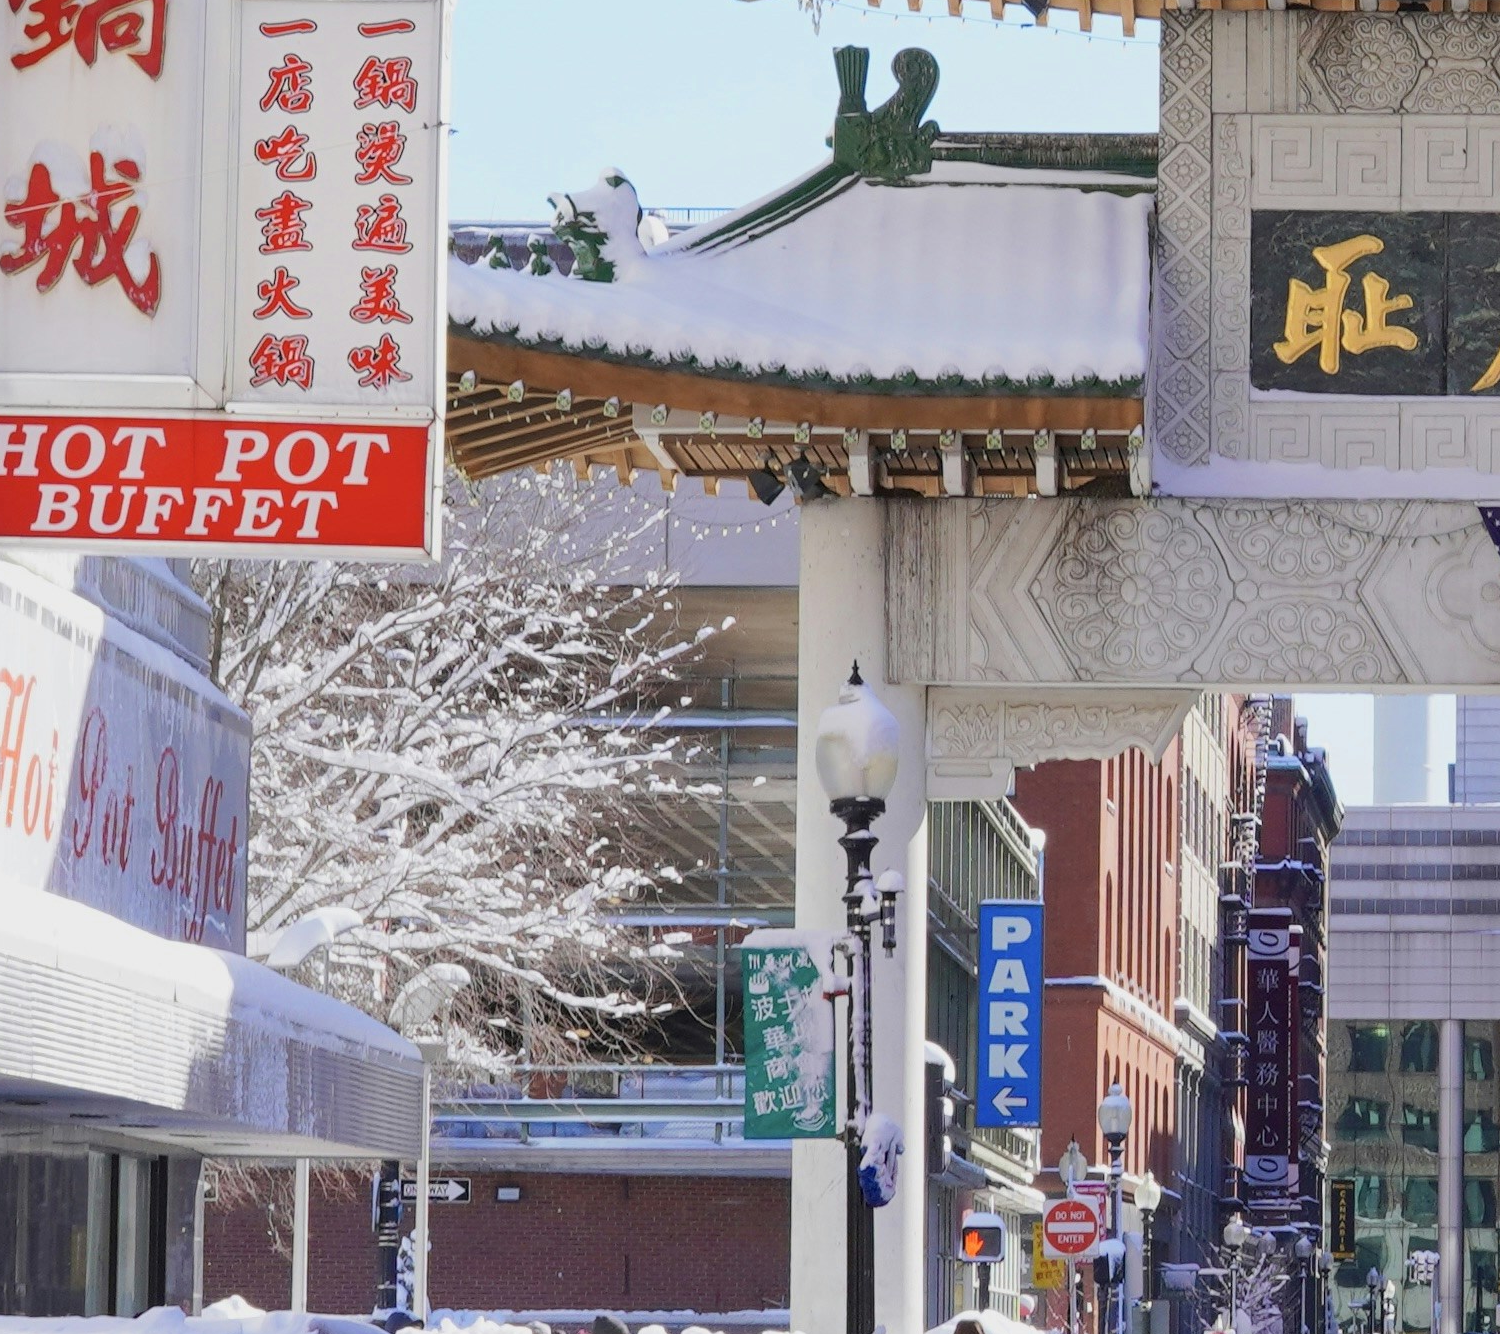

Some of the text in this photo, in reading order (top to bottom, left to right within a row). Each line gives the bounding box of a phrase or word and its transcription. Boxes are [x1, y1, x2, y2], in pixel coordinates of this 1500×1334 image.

[249, 18, 317, 391] 一店吃盡火鍋
[214, 430, 391, 486] POT
[30, 484, 339, 540] BUFFET
[74, 705, 135, 873] Pot
[151, 746, 238, 942] Buffet
[988, 916, 1032, 1079] PARK
[1256, 967, 1279, 1148] 華人醫務中心
[404, 1183, 449, 1197] ON WAY
[1055, 1211, 1087, 1221] DO NOT
[1057, 1234, 1085, 1244] ENTER
